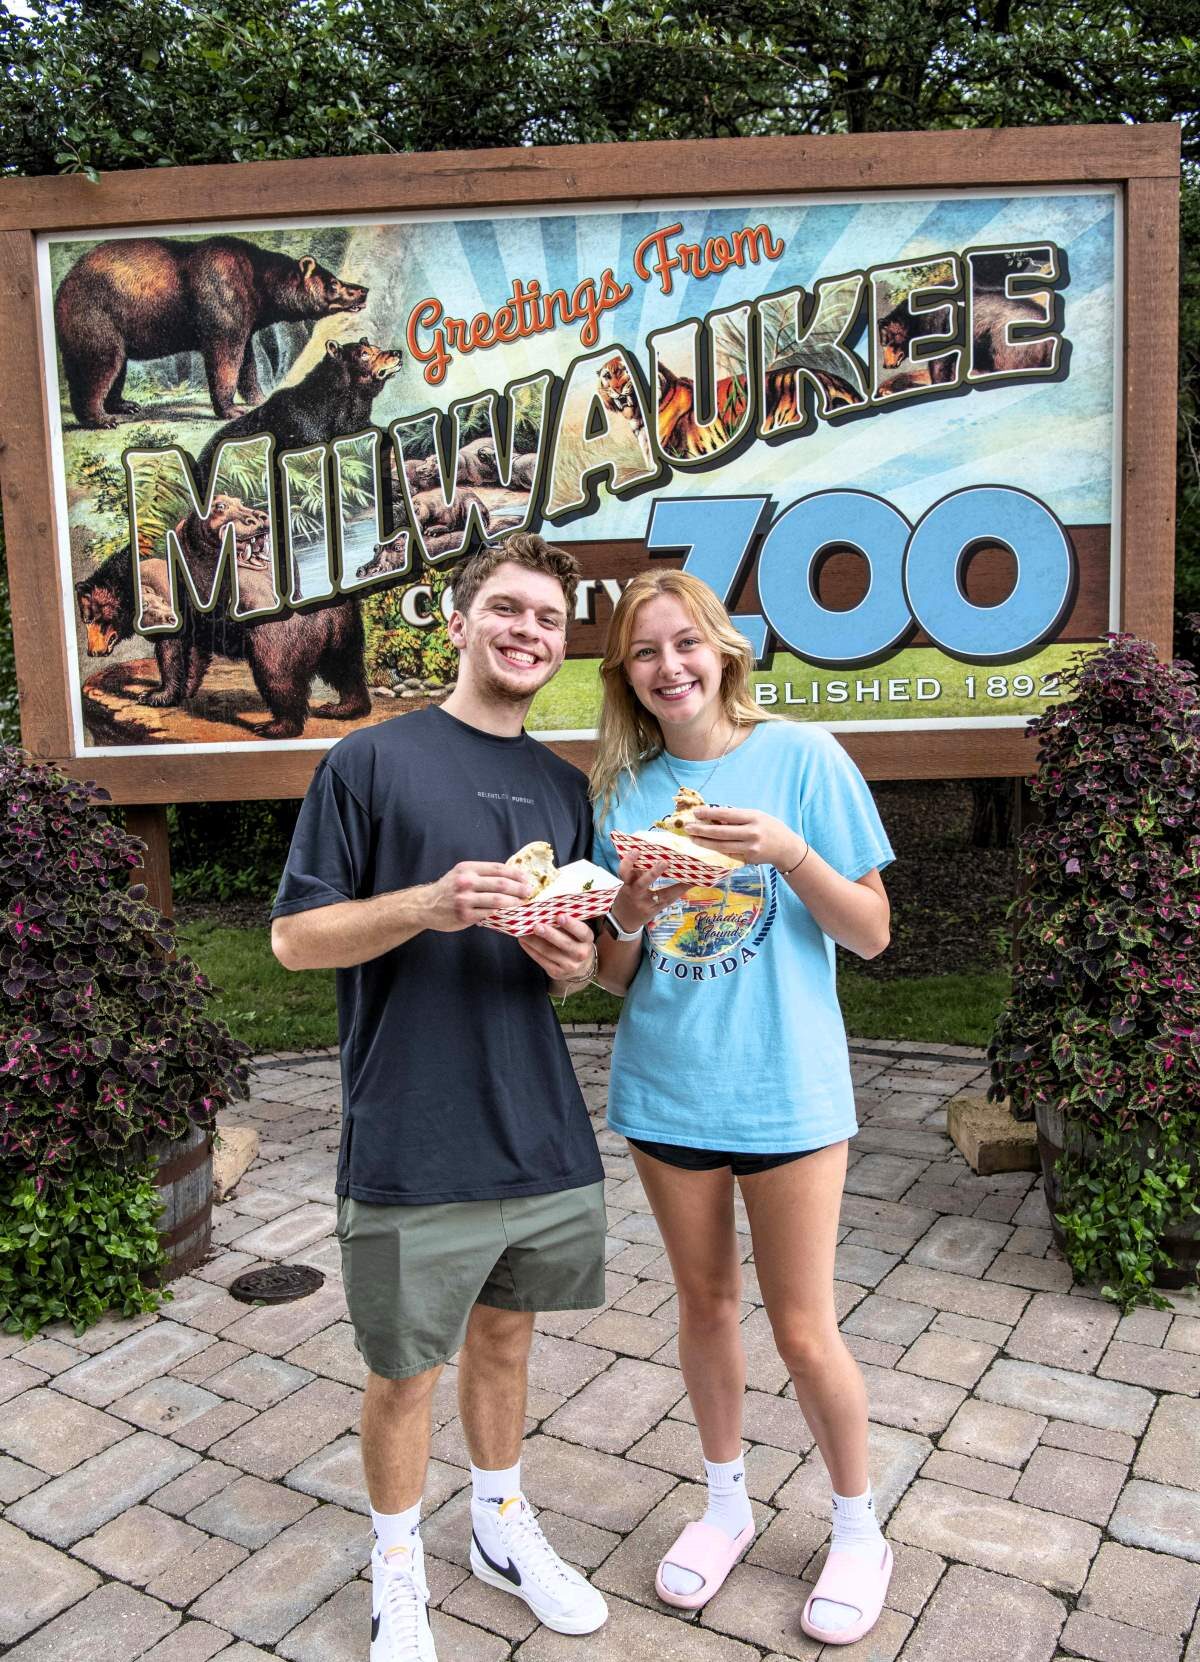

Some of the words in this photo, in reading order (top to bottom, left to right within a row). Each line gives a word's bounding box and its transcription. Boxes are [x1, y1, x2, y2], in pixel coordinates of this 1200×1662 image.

[406, 266, 632, 386] Greetings
[633, 221, 785, 296] From
[121, 241, 1070, 636] MILWAUKEE
[644, 484, 1078, 671] ZOO
[754, 677, 942, 706] BLISHED
[963, 674, 1062, 700] 1892
[650, 946, 758, 981] FLORIDA
